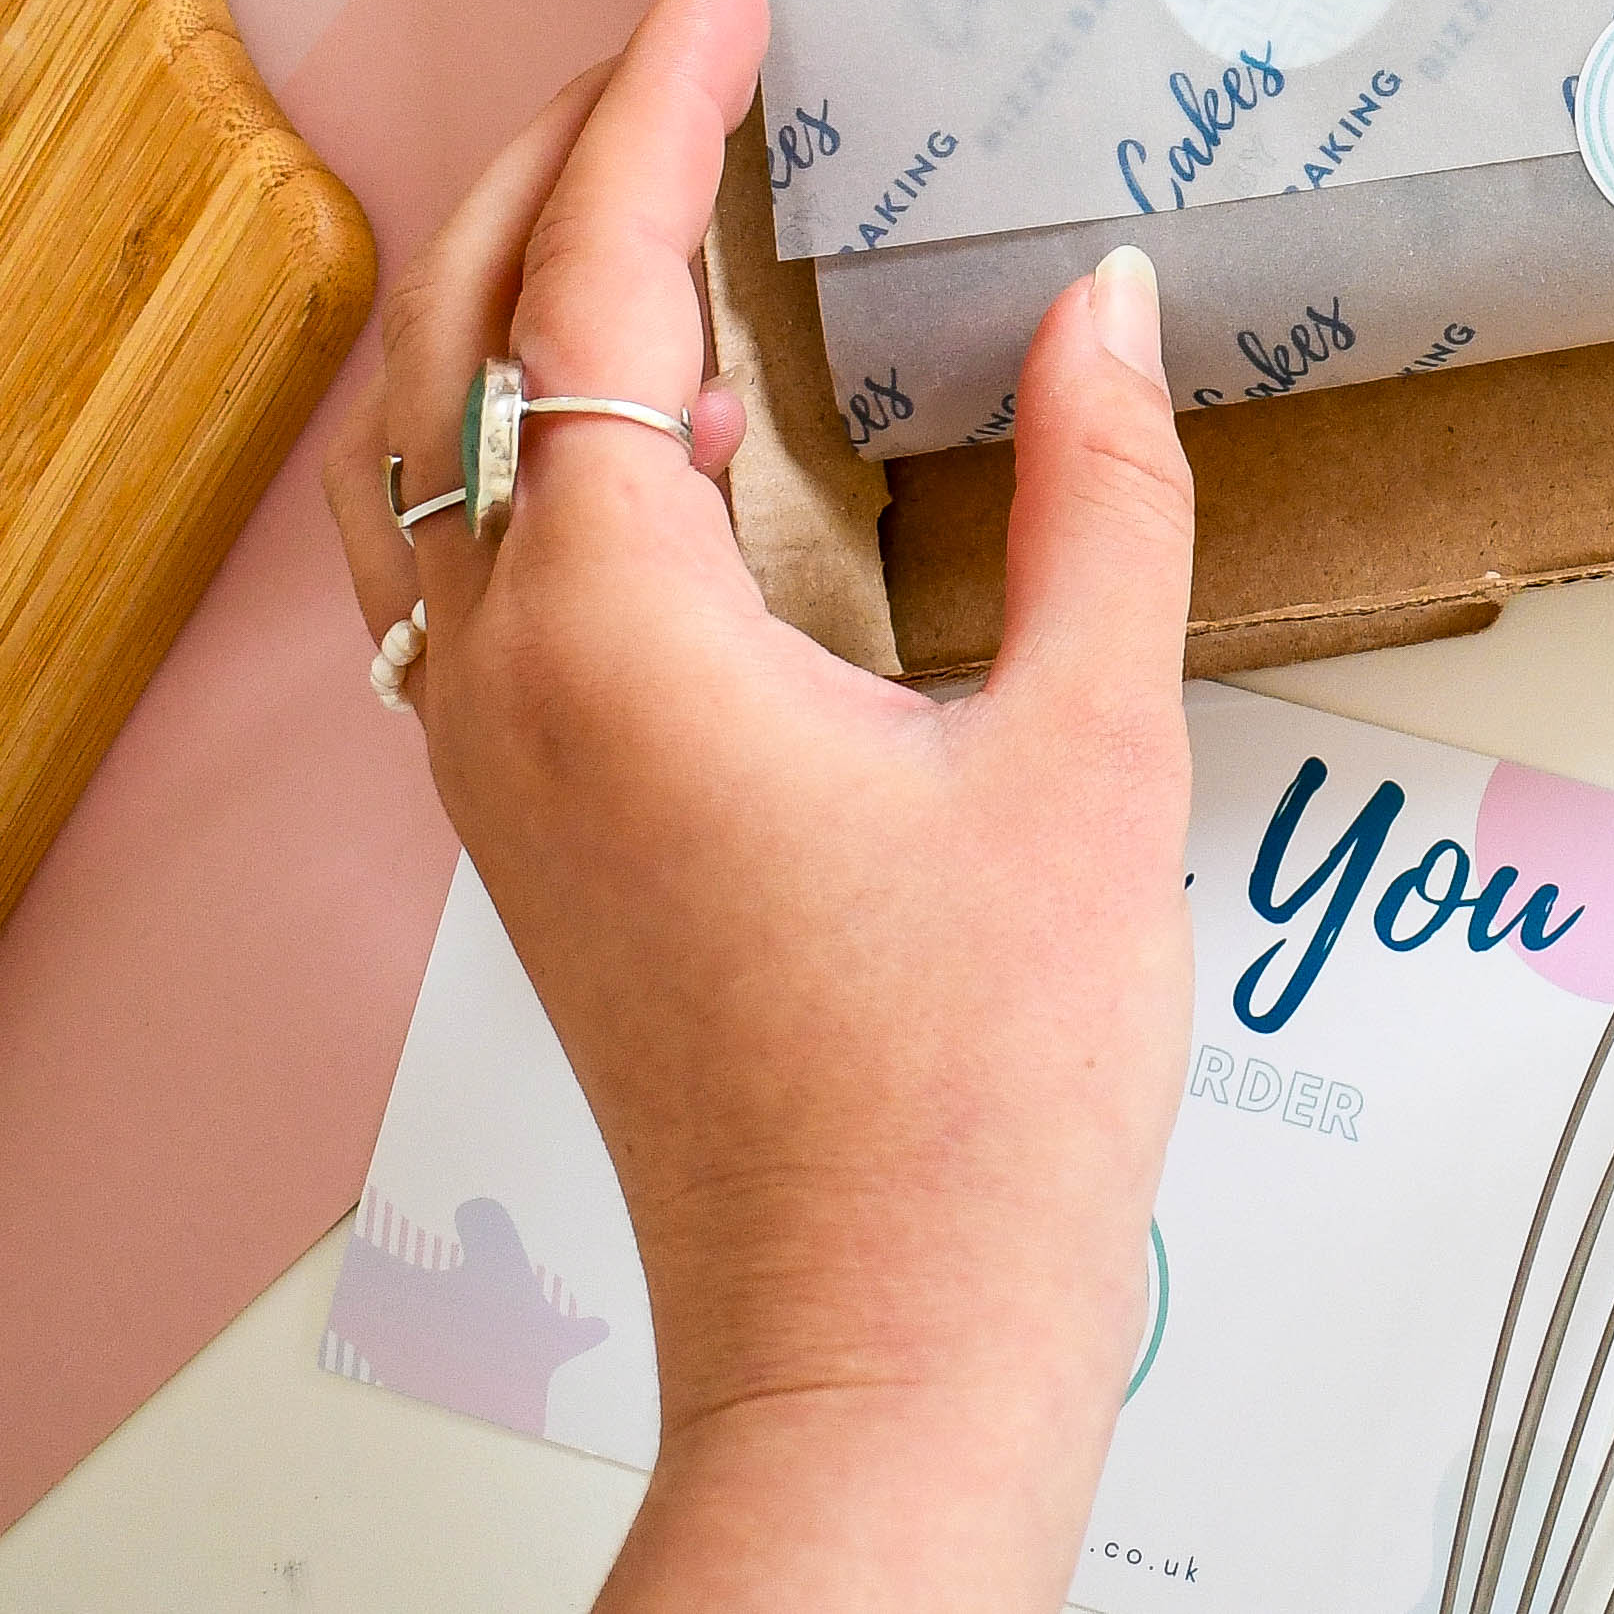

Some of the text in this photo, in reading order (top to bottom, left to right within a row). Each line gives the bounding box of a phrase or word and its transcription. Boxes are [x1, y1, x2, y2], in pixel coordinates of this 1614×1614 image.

[840, 130, 959, 254] AKING
[1117, 40, 1285, 214] Cakes
[1283, 70, 1403, 194] AKING
[1232, 756, 1584, 1034] You
